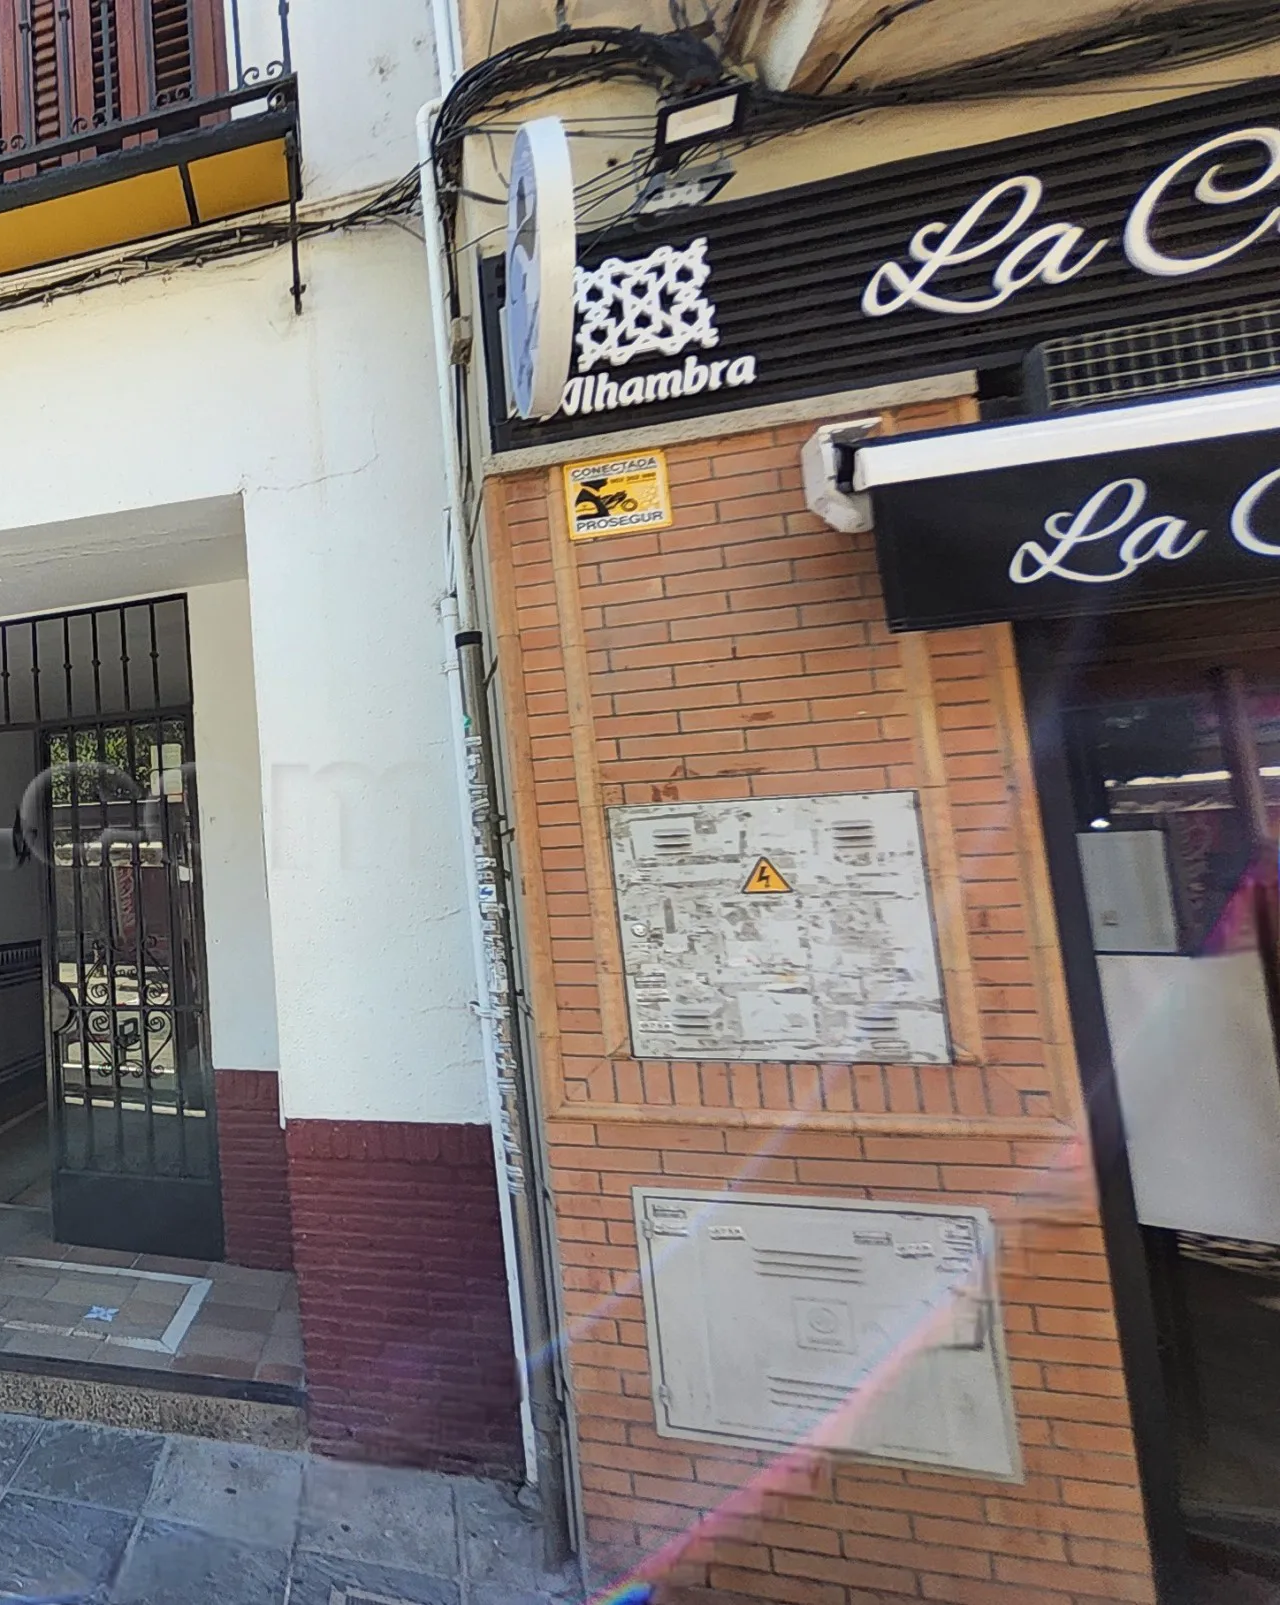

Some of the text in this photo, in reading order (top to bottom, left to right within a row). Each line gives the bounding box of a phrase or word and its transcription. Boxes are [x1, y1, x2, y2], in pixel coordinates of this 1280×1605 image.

[861, 175, 1109, 317] La
[560, 355, 757, 416] Alhambra
[571, 457, 657, 478] CONECTADA
[576, 511, 664, 532] PROSEGUR
[1009, 478, 1208, 583] La
